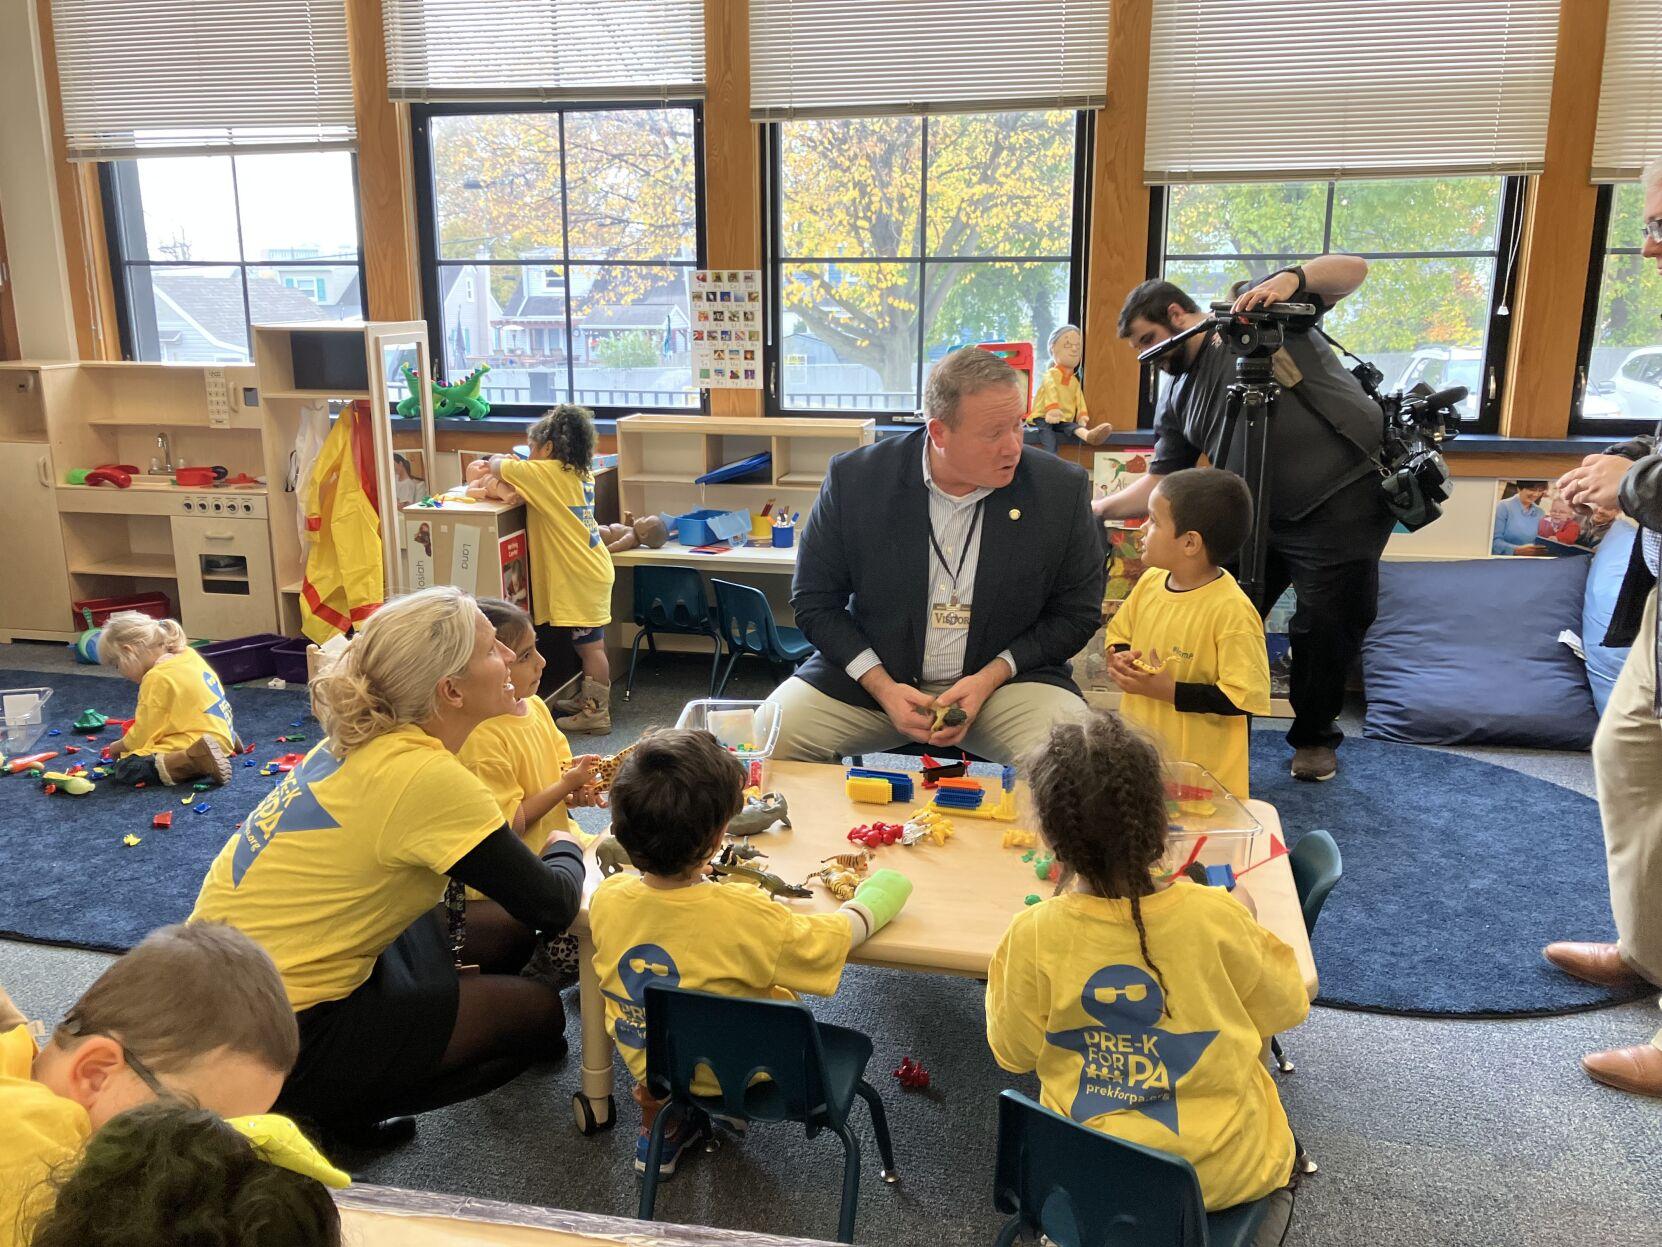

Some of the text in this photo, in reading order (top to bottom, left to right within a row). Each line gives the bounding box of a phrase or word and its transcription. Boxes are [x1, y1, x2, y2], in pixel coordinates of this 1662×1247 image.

[462, 544, 471, 570] Lana
[416, 560, 427, 590] Josiah
[1084, 1031, 1160, 1058] PRE-K
[1088, 1046, 1170, 1090] FOR PA
